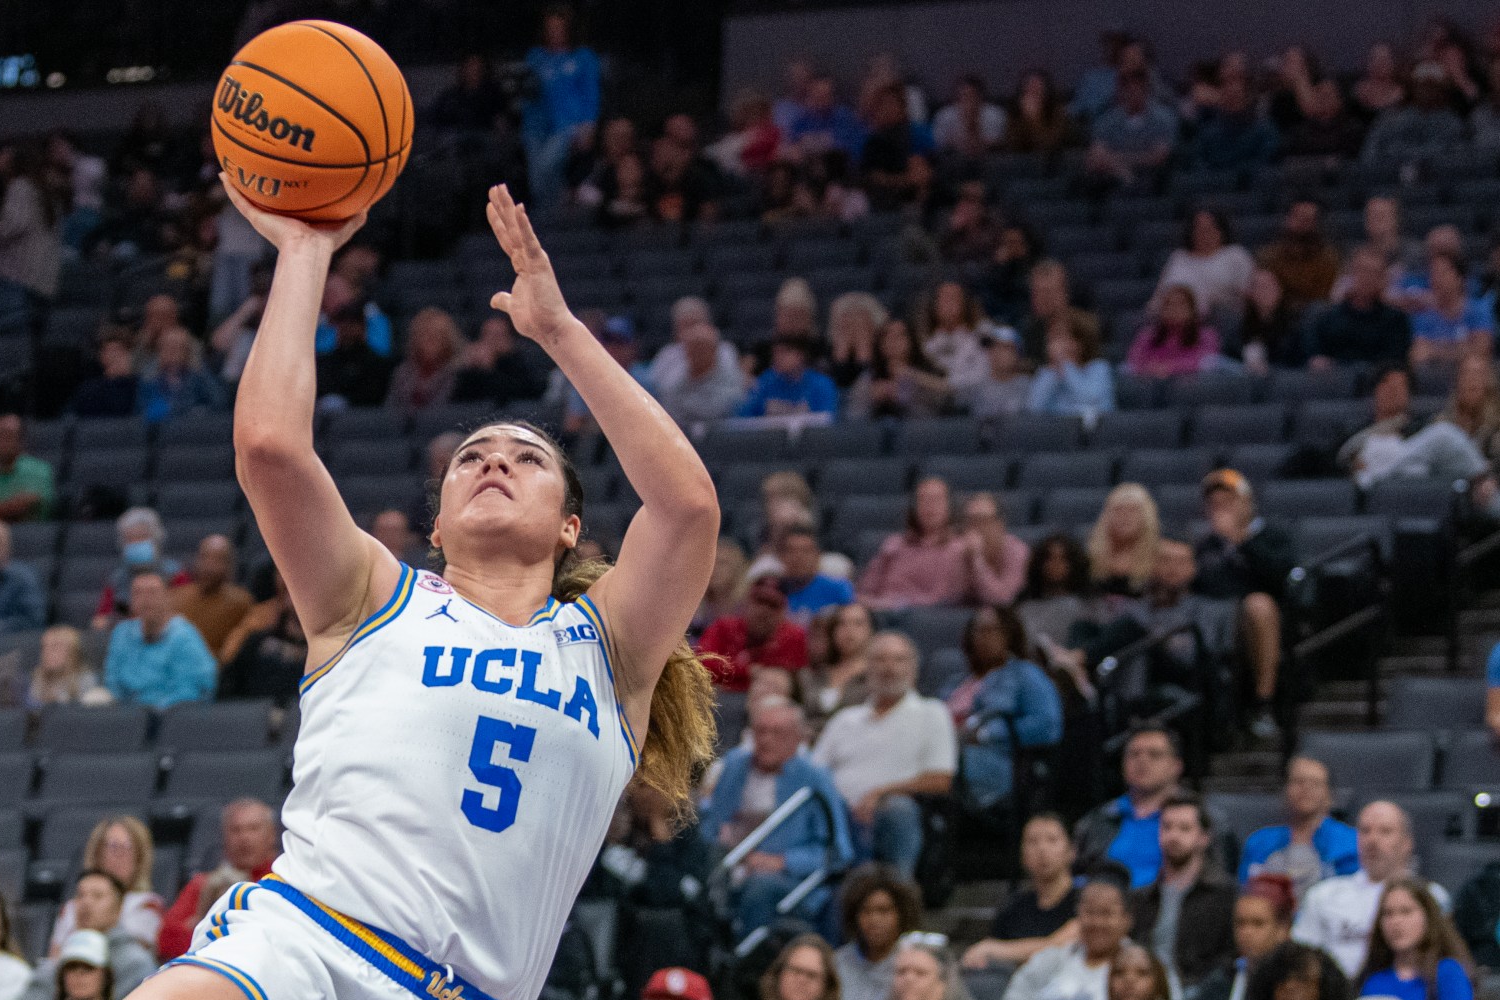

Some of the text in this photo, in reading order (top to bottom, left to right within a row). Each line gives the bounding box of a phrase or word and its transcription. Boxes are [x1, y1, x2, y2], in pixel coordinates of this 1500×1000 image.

[218, 75, 315, 152] Wilson
[422, 646, 600, 740] UCLA
[460, 715, 537, 833] 5
